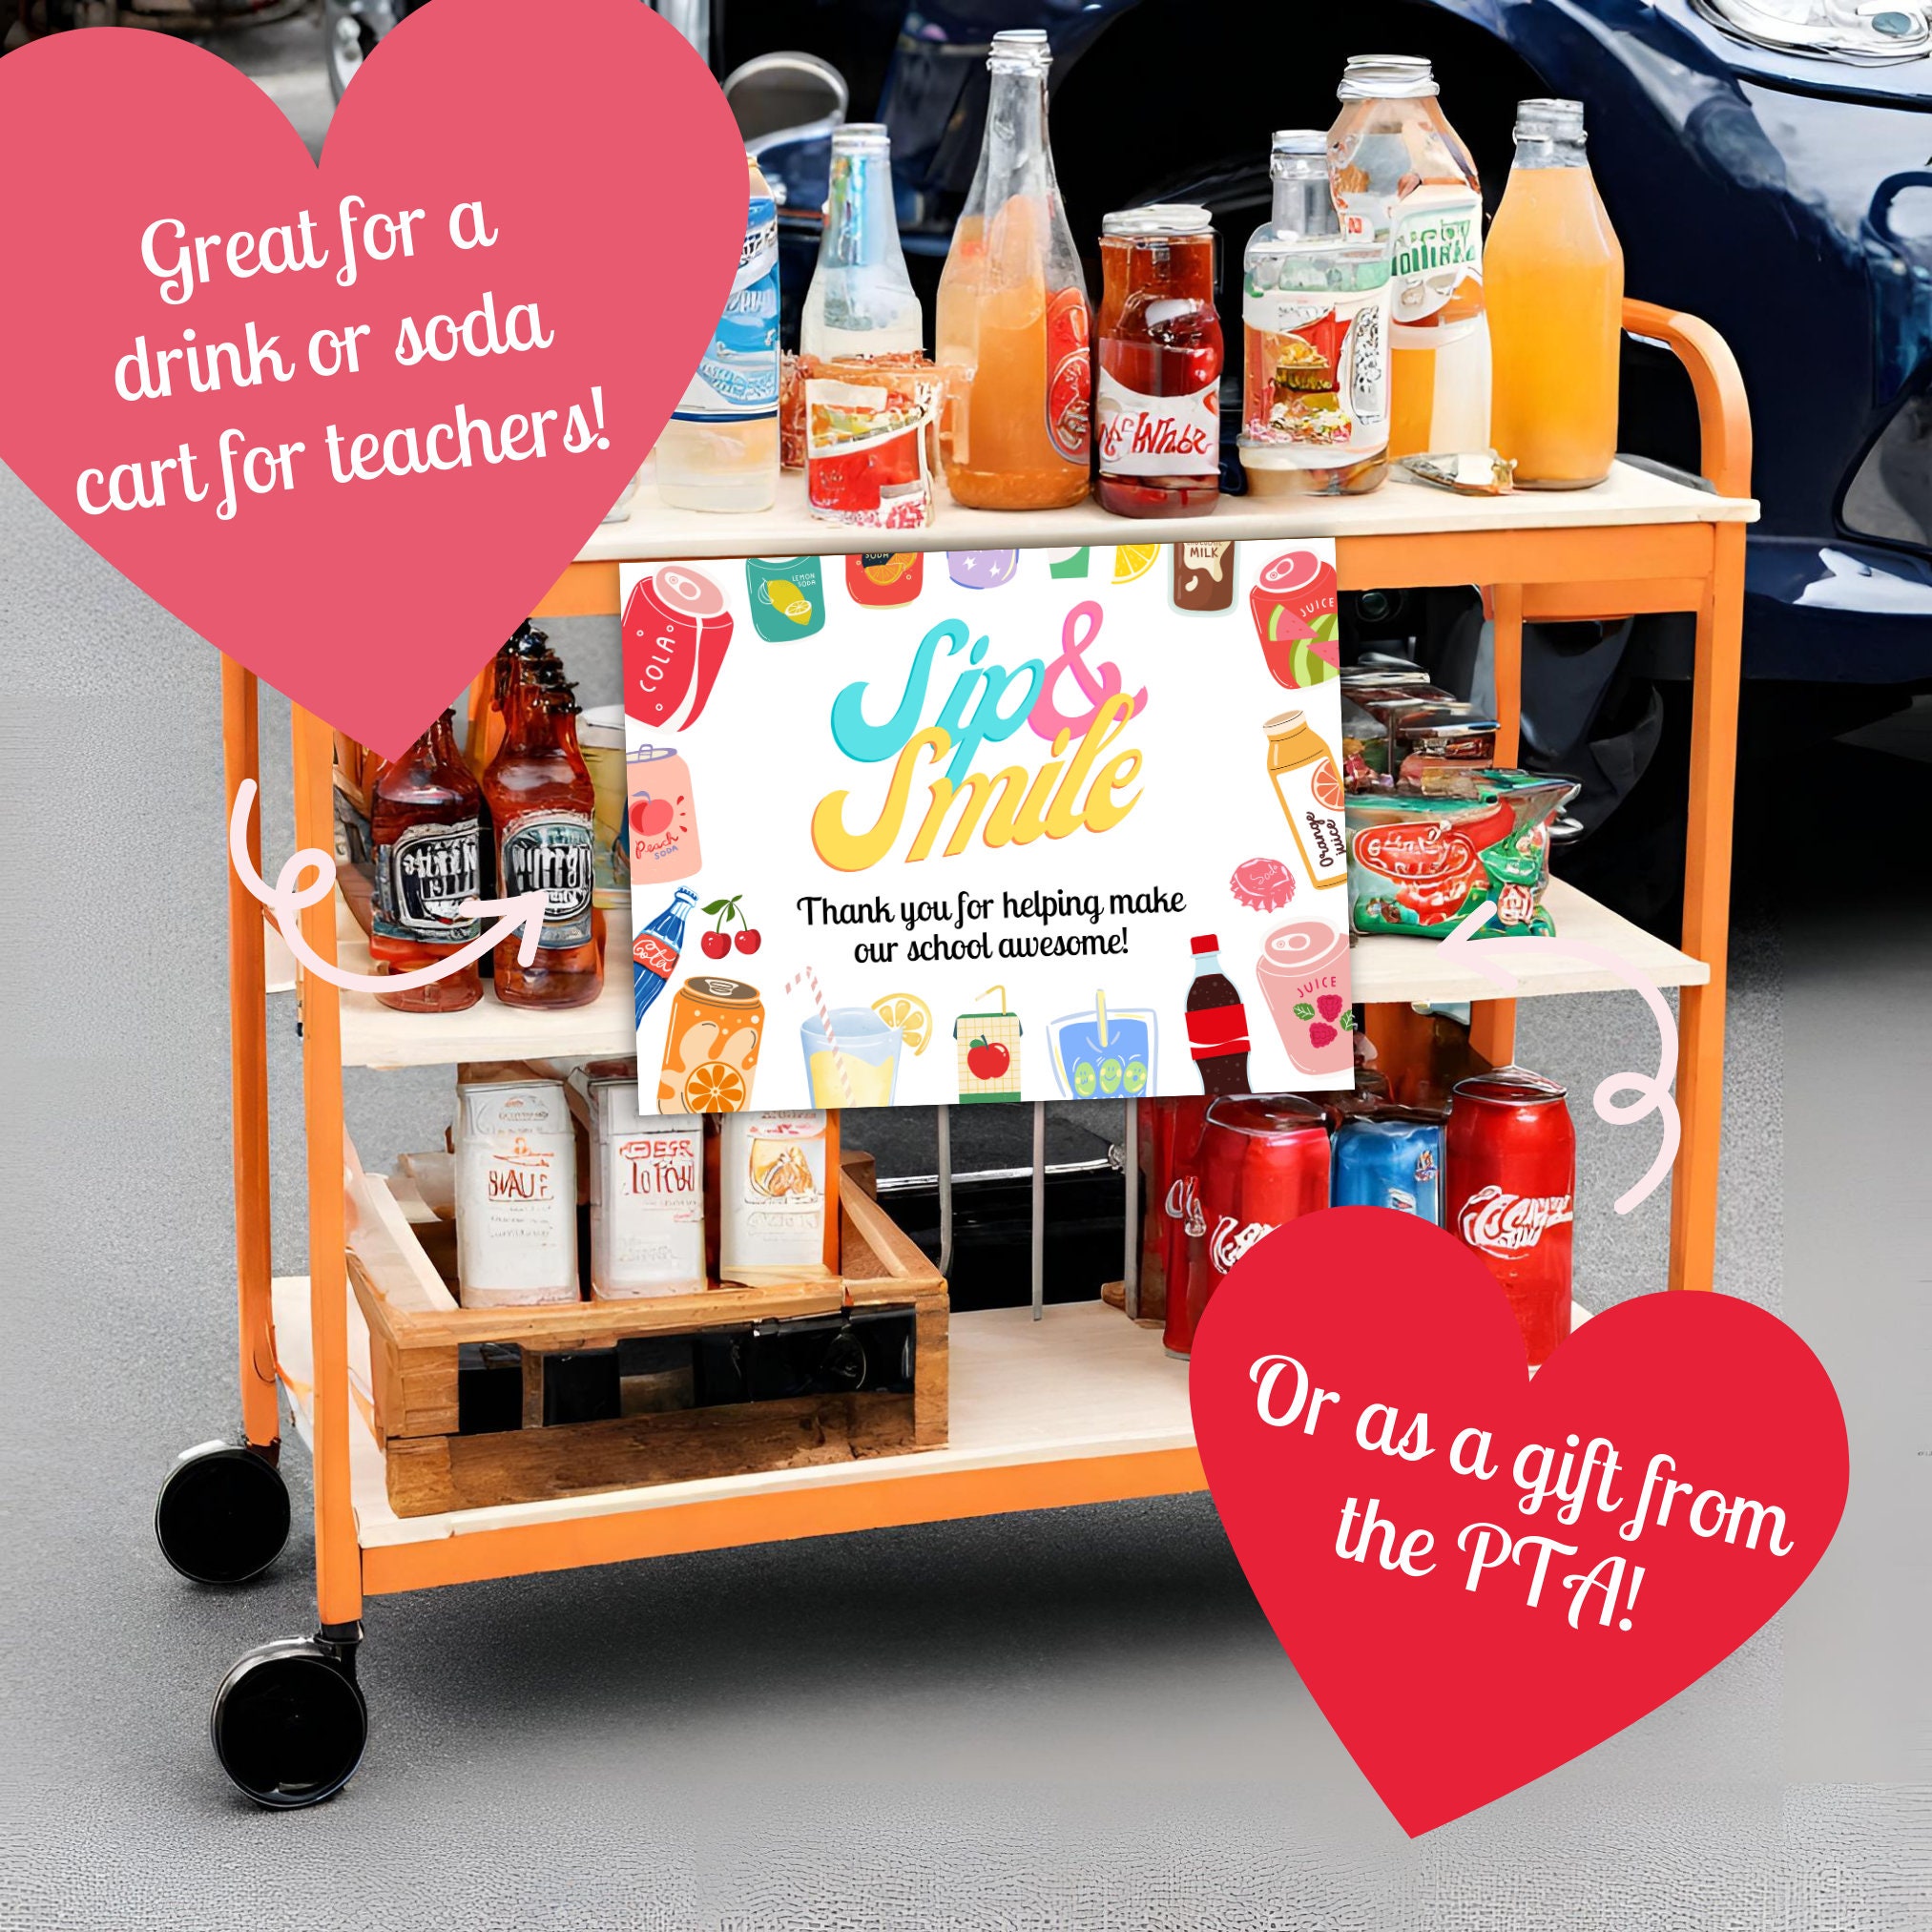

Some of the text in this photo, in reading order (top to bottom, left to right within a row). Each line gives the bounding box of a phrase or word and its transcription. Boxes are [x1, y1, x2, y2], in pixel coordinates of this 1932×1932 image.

[1190, 547, 1219, 558] MILK
[791, 572, 816, 583] LEMON
[798, 579, 817, 588] SODA
[1299, 597, 1335, 617] JUICE
[639, 636, 675, 693] COLA
[831, 601, 1148, 796] Sip &
[811, 694, 1145, 872] Smile
[635, 832, 679, 860] Peach
[1306, 811, 1335, 867] Orange
[654, 845, 678, 860] SODA
[1250, 863, 1278, 884] Soda
[797, 885, 1187, 932] Thank you for helping make
[854, 926, 1129, 965] our school awesome!
[1297, 976, 1337, 998] JUICE
